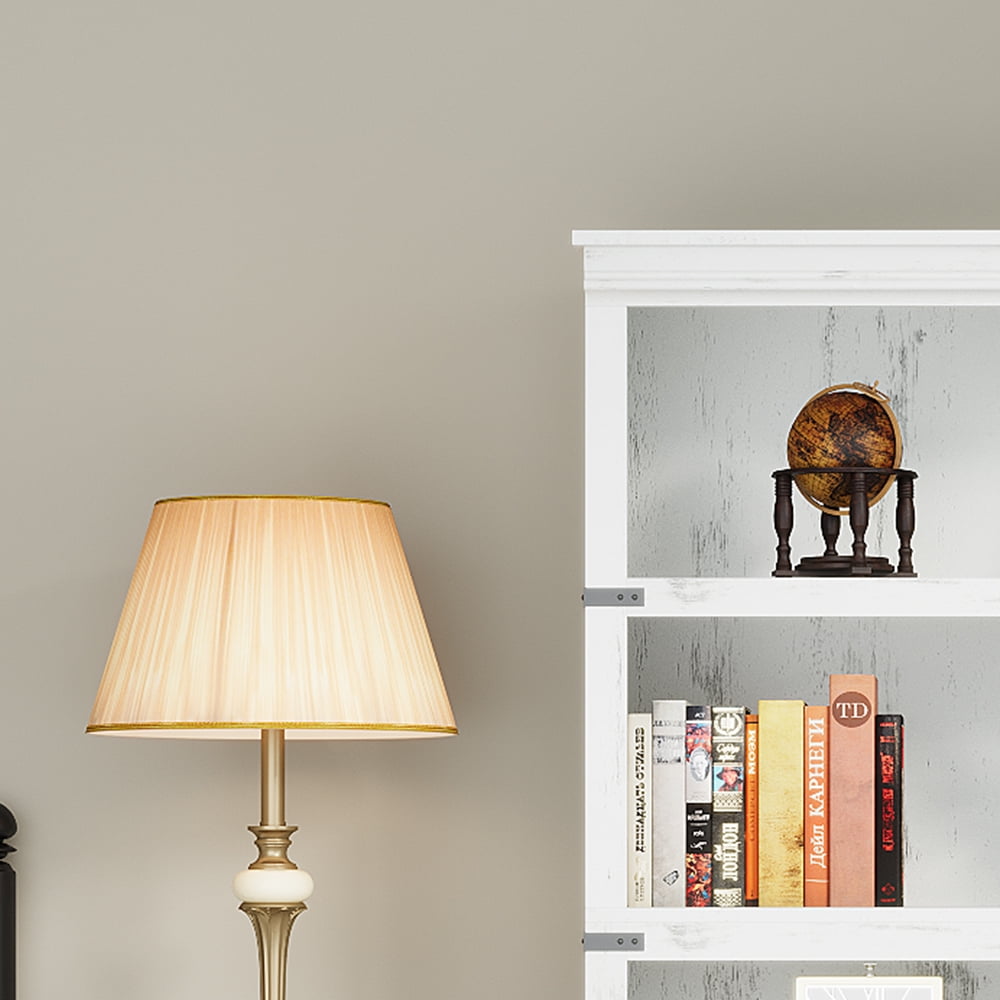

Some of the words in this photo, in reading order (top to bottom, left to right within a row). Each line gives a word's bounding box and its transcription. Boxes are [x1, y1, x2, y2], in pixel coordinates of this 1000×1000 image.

[835, 702, 869, 720] TD
[748, 729, 756, 775] МОЭМ
[809, 717, 825, 818] КАРНЕГИ
[722, 822, 742, 881] ЛОНДОН
[810, 824, 826, 868] Дейл
